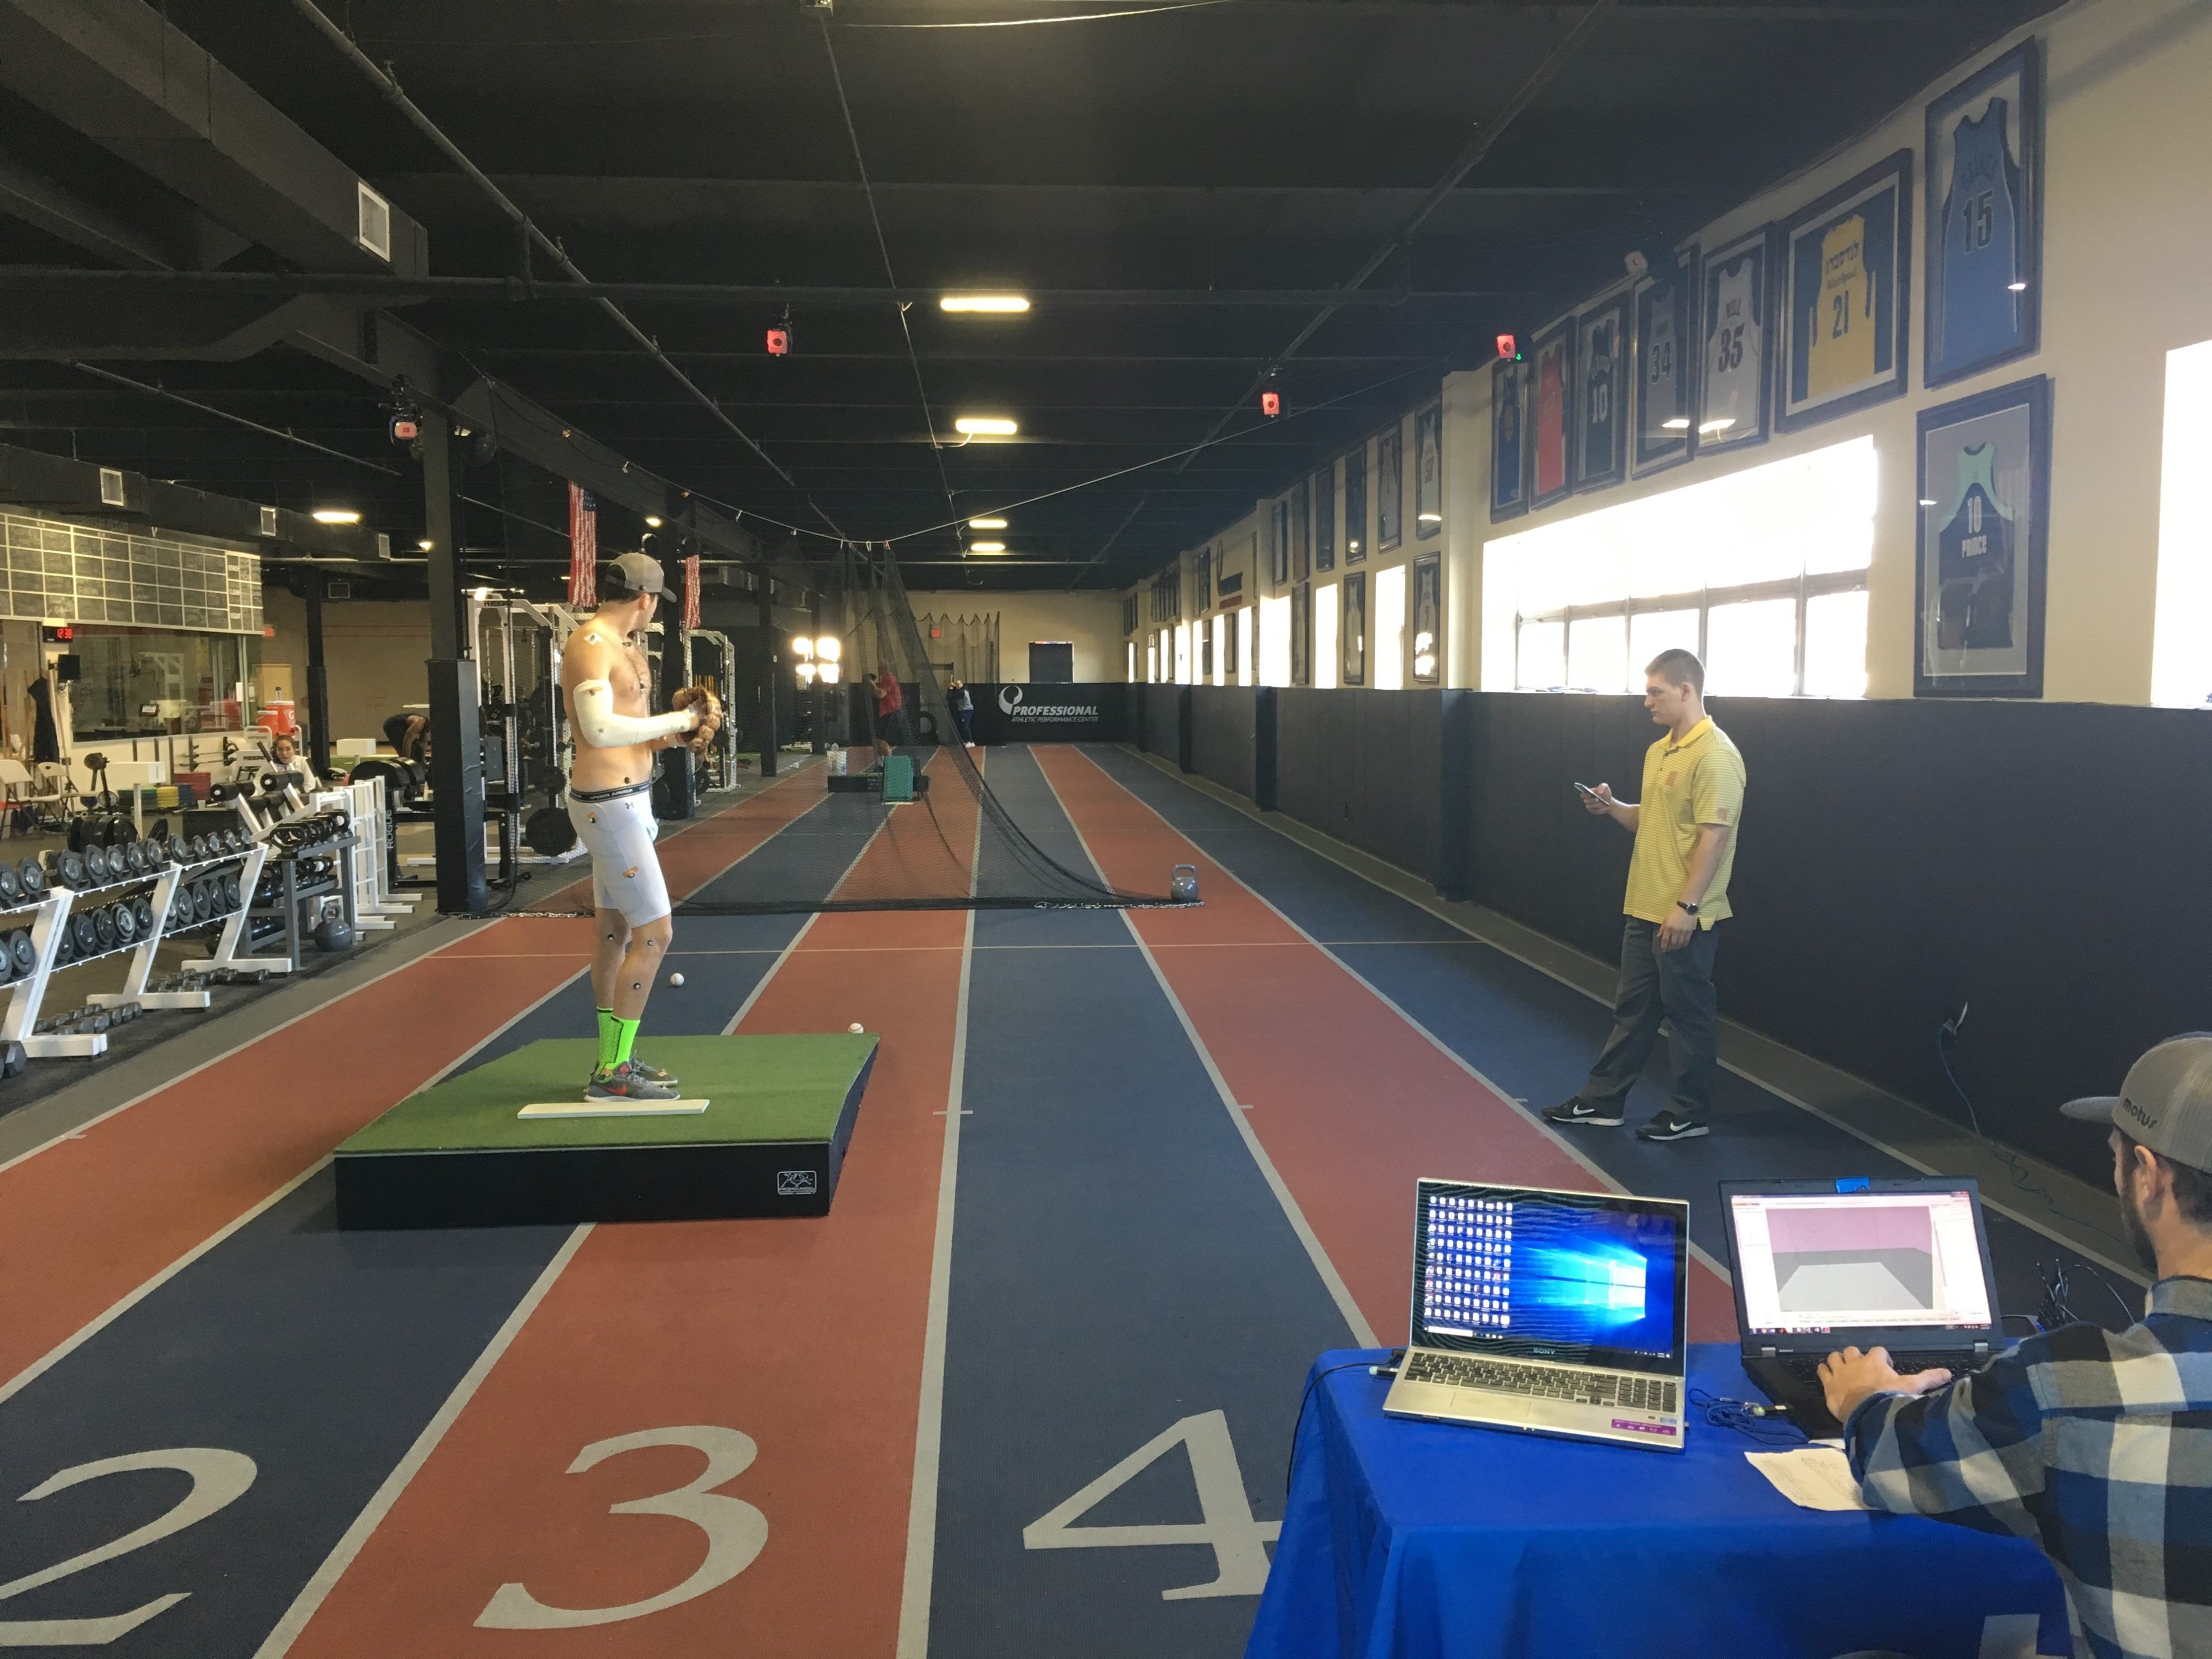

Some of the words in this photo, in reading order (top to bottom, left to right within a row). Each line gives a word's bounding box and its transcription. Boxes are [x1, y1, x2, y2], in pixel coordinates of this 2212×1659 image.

[1963, 189, 1993, 255] 15
[1832, 290, 1849, 339] 21
[1651, 340, 1671, 384] 34
[1718, 323, 1745, 373] 35
[1592, 384, 1608, 424] 10
[1968, 496, 1982, 534] 10
[1961, 535, 1987, 558] PRINCE
[1013, 706, 1098, 716] PROFESSIONAL
[2123, 1098, 2158, 1129] motus
[473, 1425, 769, 1629] 3
[1022, 1409, 1283, 1600] 4
[0, 1448, 258, 1647] 2
